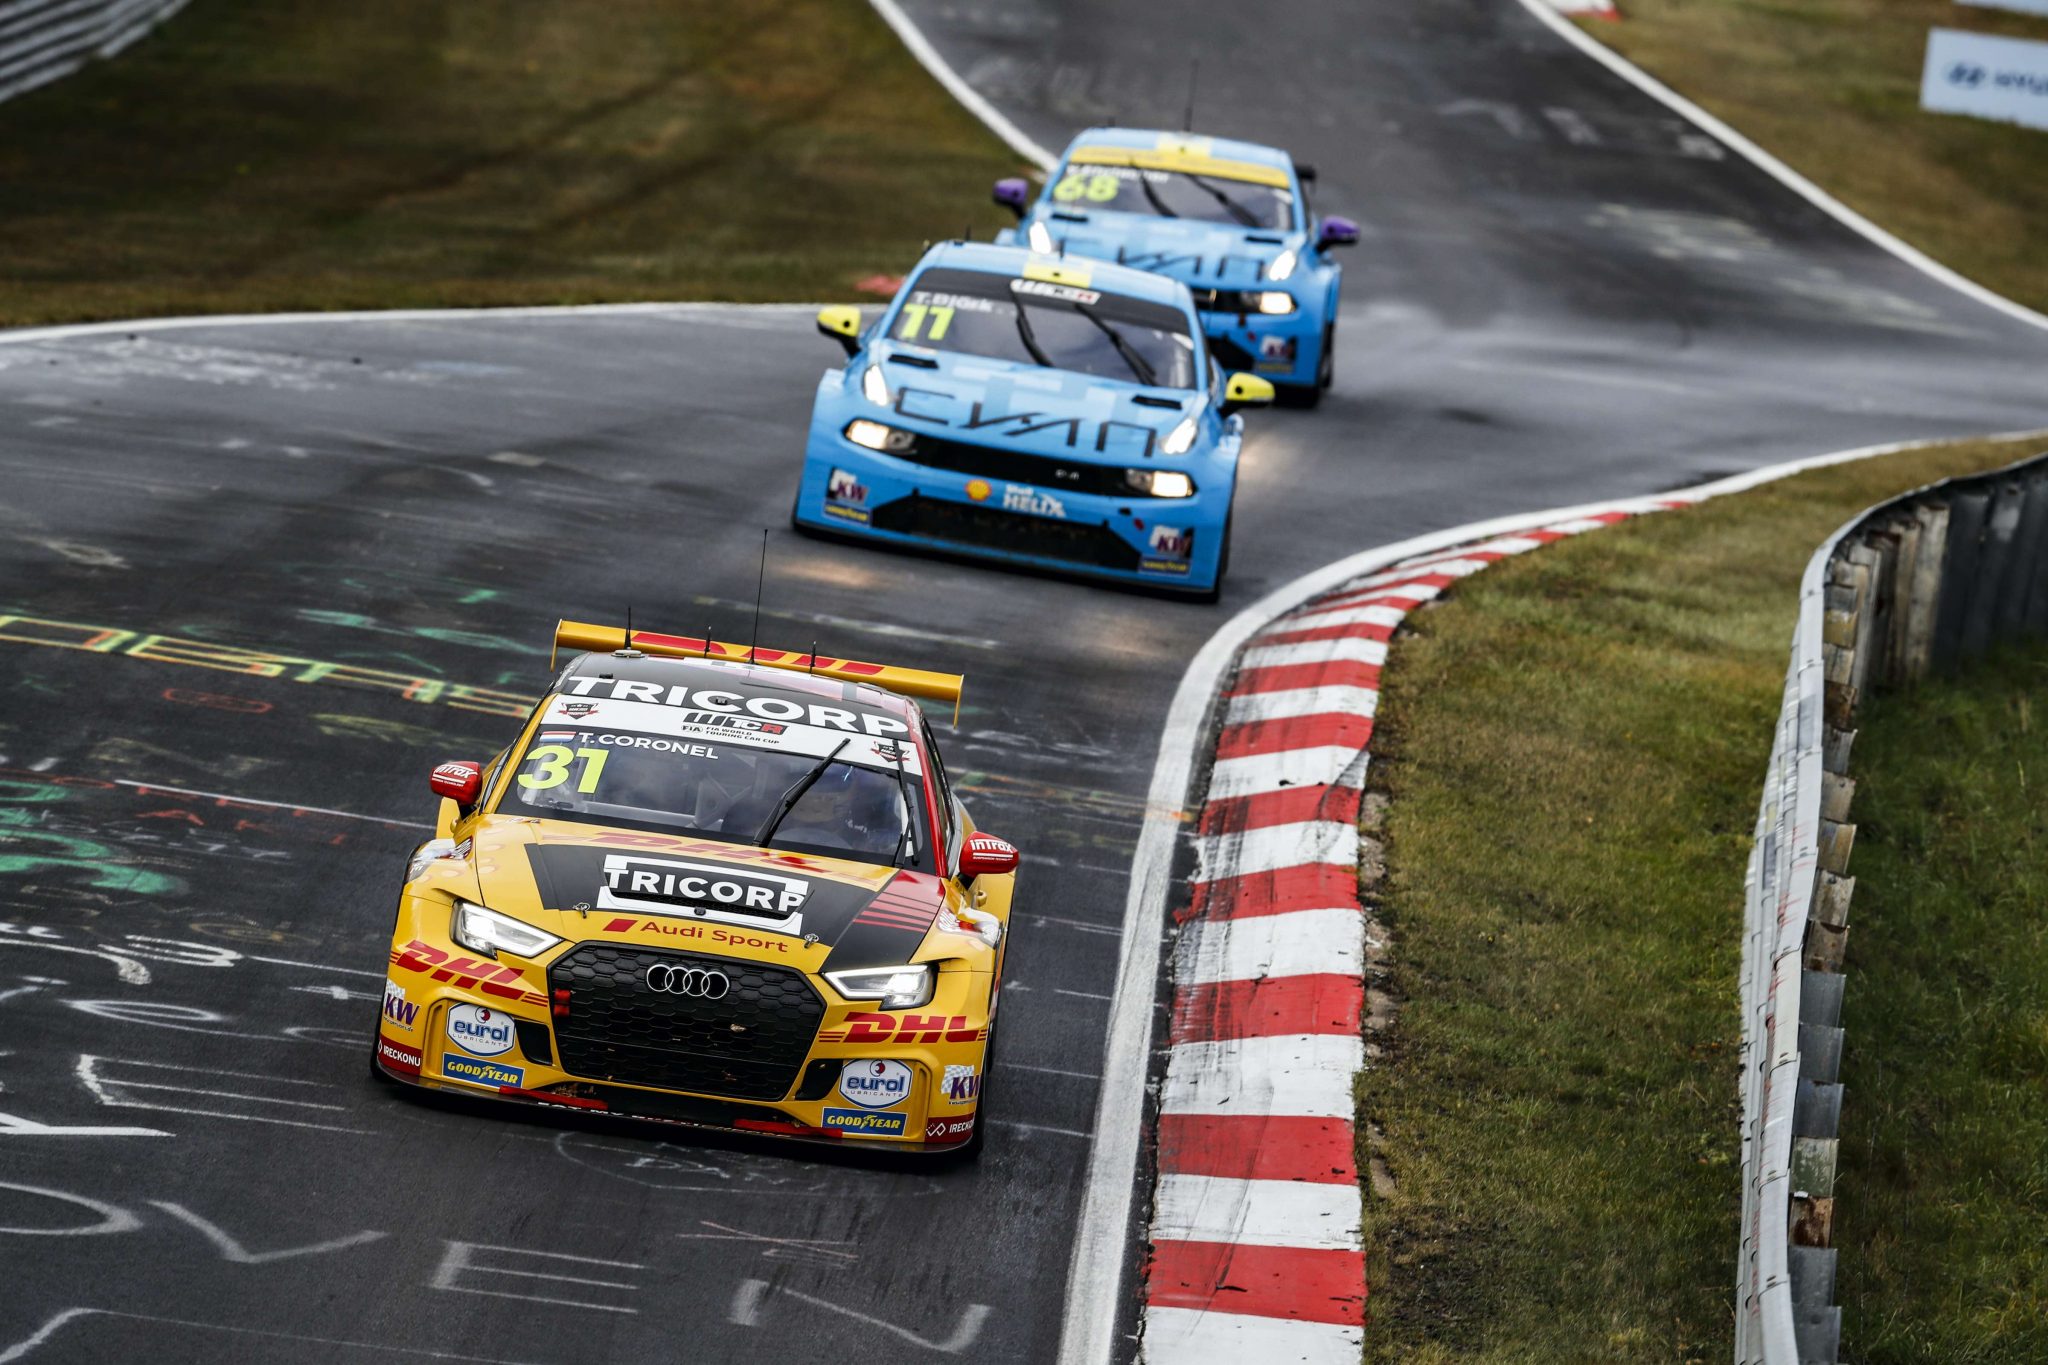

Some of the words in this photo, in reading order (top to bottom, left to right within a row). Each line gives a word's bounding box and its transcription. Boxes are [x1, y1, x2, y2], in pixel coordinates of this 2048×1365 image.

[1054, 174, 1120, 202] 68
[900, 304, 954, 340] 11
[1002, 493, 1068, 519] HELIX
[568, 676, 908, 737] TRICORP
[706, 730, 743, 739] TOURING
[722, 728, 753, 736] WORLD
[579, 732, 719, 760] T.CORONEL
[517, 745, 610, 794] 31
[603, 868, 806, 913] TRICORP
[640, 921, 703, 939] Audi
[711, 929, 789, 953] Sport
[395, 939, 525, 1000] DHL
[384, 993, 421, 1026] KW
[452, 1033, 508, 1048] LUBRICANTS
[454, 1019, 510, 1043] eurol
[843, 1012, 979, 1044] DHL
[383, 1045, 421, 1067] IRECKONU
[447, 1061, 519, 1085] GOODYEAR
[847, 1074, 905, 1092] eurol
[845, 1089, 903, 1098] LUBRICANTS
[827, 1114, 901, 1130] GOODYEAR
